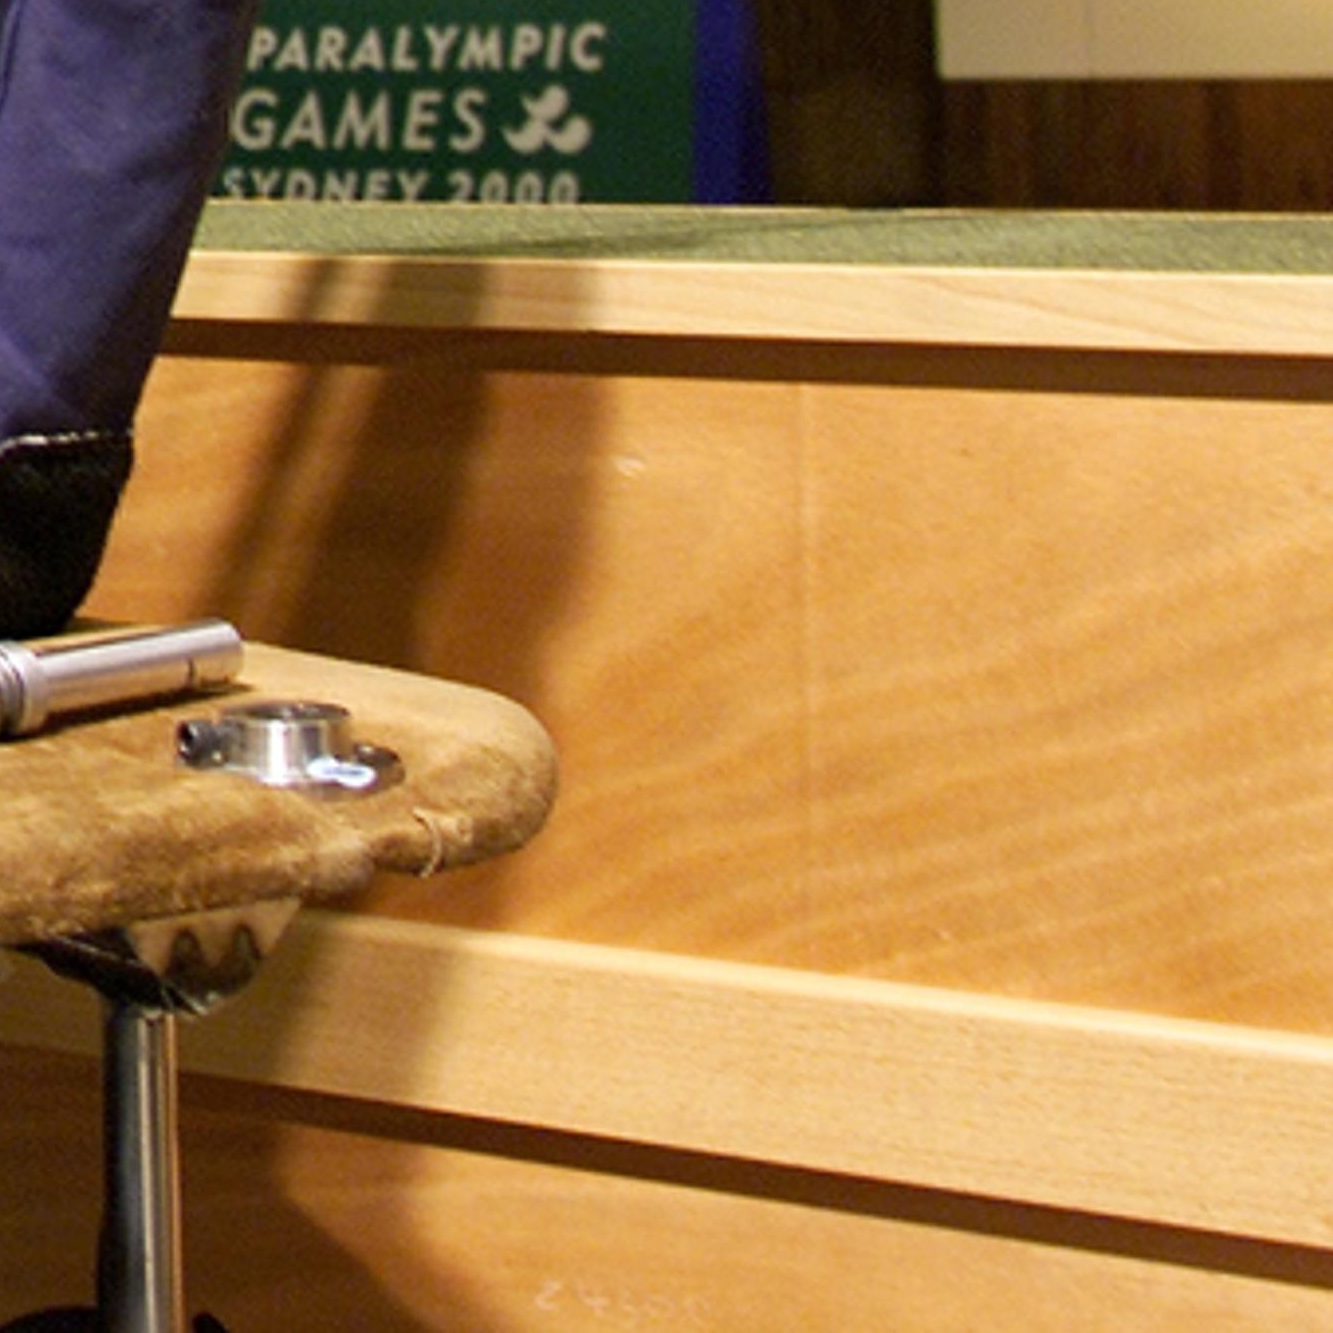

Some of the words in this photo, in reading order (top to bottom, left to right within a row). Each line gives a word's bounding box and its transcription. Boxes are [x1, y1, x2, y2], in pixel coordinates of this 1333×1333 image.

[246, 21, 607, 72] PARALYMPIC
[233, 88, 488, 152] GAMES
[223, 167, 430, 204] SYDNEY
[447, 170, 581, 205] 2000
